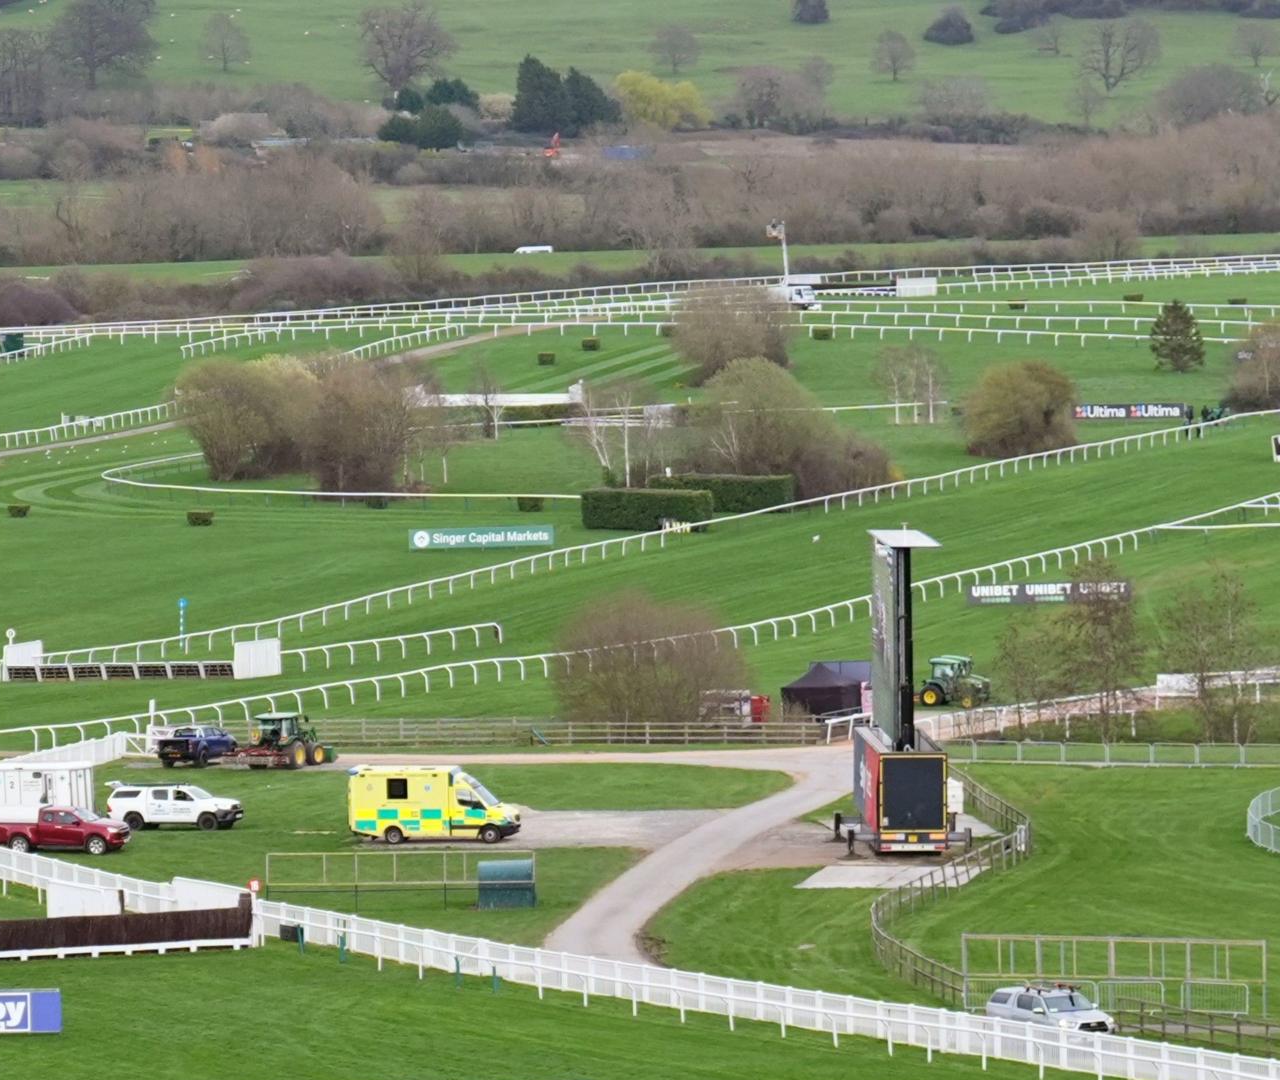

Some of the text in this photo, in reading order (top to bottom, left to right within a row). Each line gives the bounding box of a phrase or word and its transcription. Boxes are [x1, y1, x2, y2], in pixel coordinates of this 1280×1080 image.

[1087, 405, 1126, 418] Ultima
[1142, 404, 1180, 417] Ultima
[433, 530, 549, 546] Singer Capital Markets
[972, 584, 1019, 597] UNIBET
[1025, 583, 1072, 595] UNIBET
